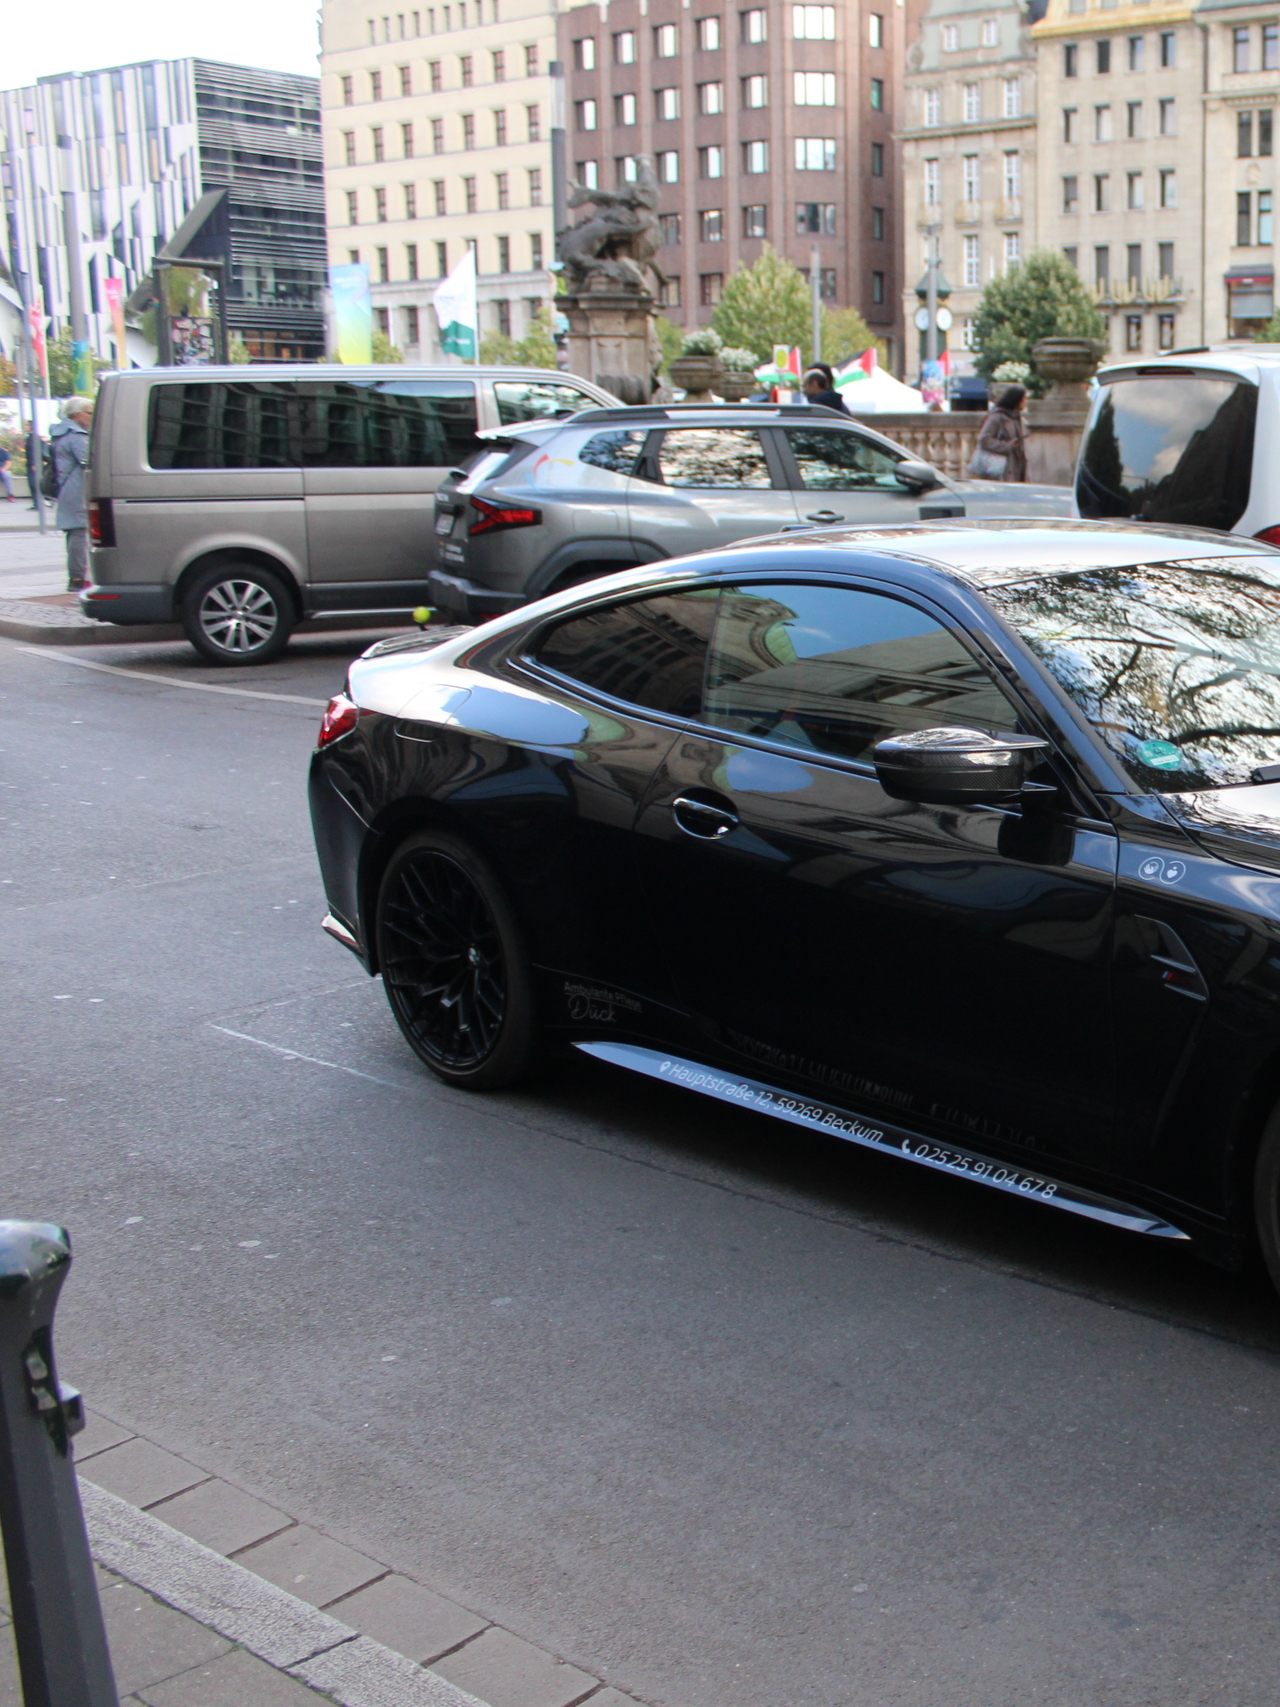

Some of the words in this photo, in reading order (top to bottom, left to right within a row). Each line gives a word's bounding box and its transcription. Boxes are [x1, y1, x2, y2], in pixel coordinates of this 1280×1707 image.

[563, 981, 614, 1001] Ambulante
[568, 994, 617, 1022] Dück
[668, 1063, 754, 1101] Hauptstraße
[755, 1091, 773, 1109] 12,
[773, 1097, 822, 1122] 59269
[821, 1112, 884, 1142] Beckum
